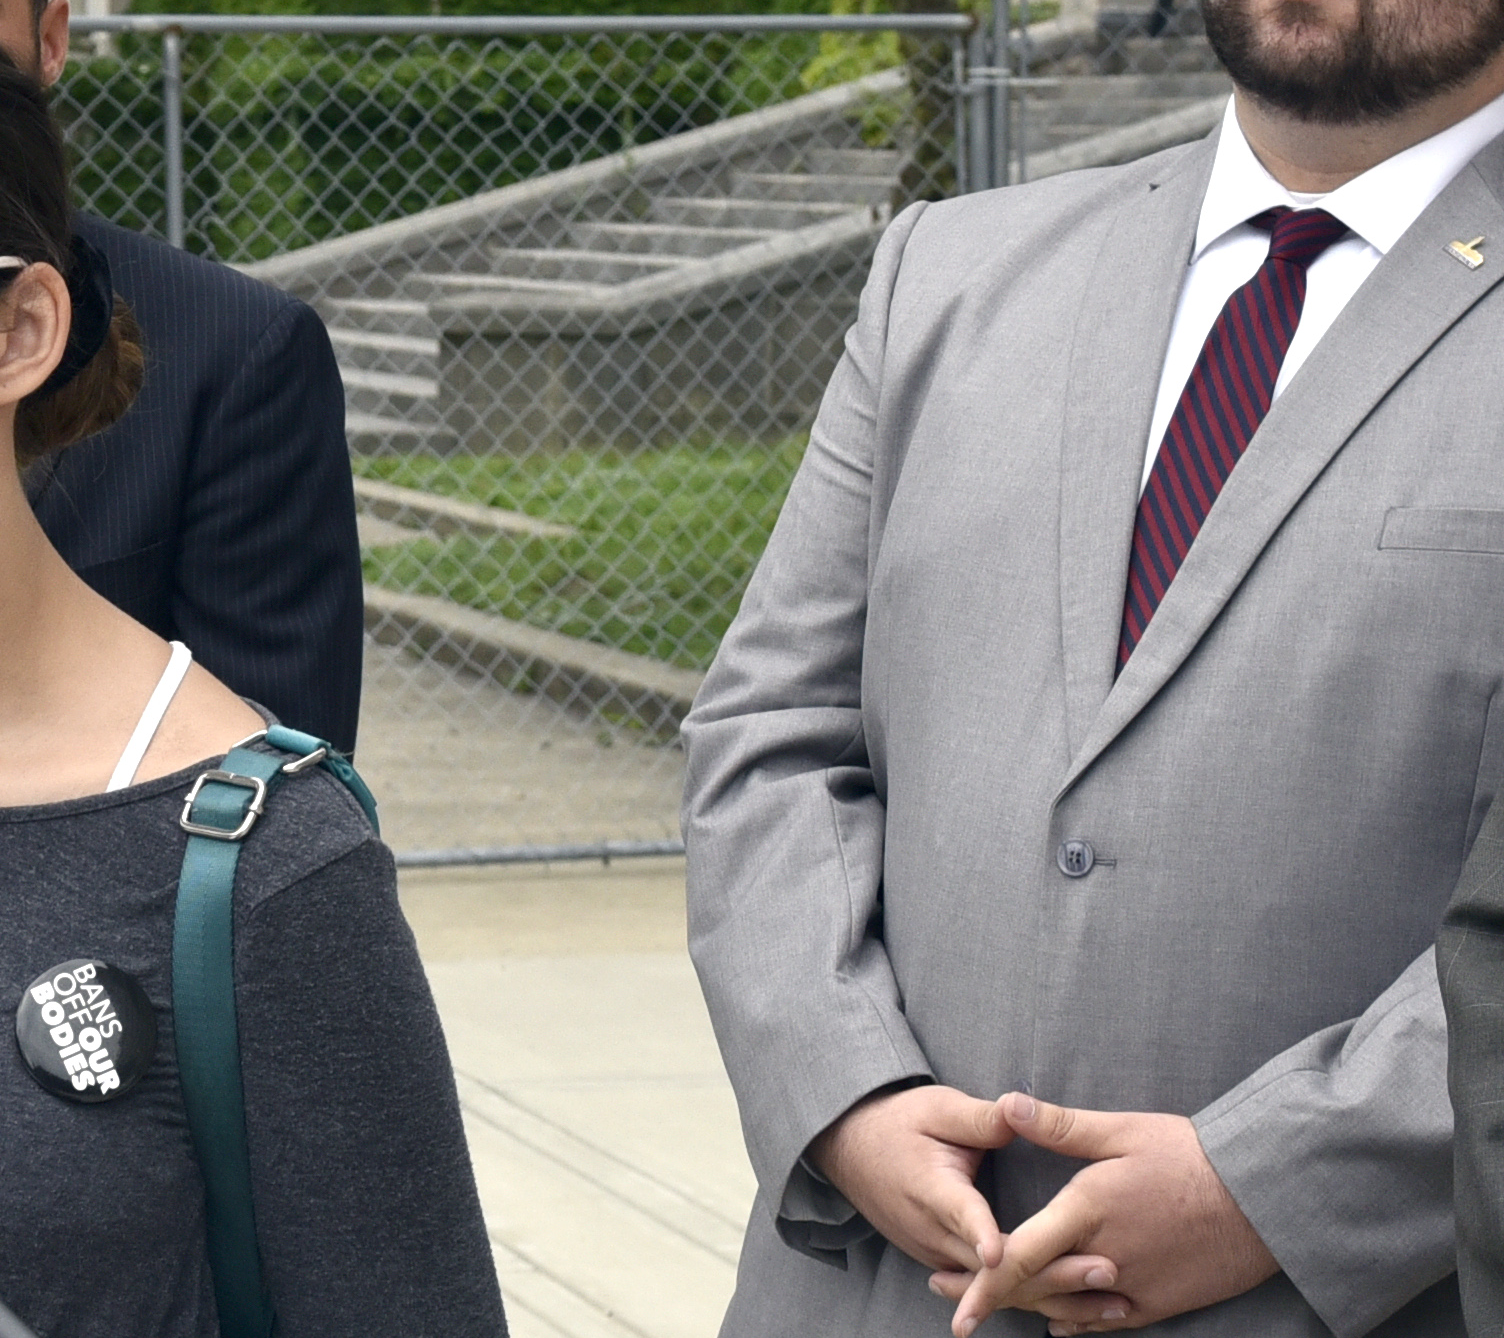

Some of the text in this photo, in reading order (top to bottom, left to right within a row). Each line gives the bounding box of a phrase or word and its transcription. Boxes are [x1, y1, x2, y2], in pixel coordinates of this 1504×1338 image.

[30, 981, 95, 1091] BODIES
[53, 973, 120, 1095] OFF OUR
[73, 963, 123, 1038] BANS
